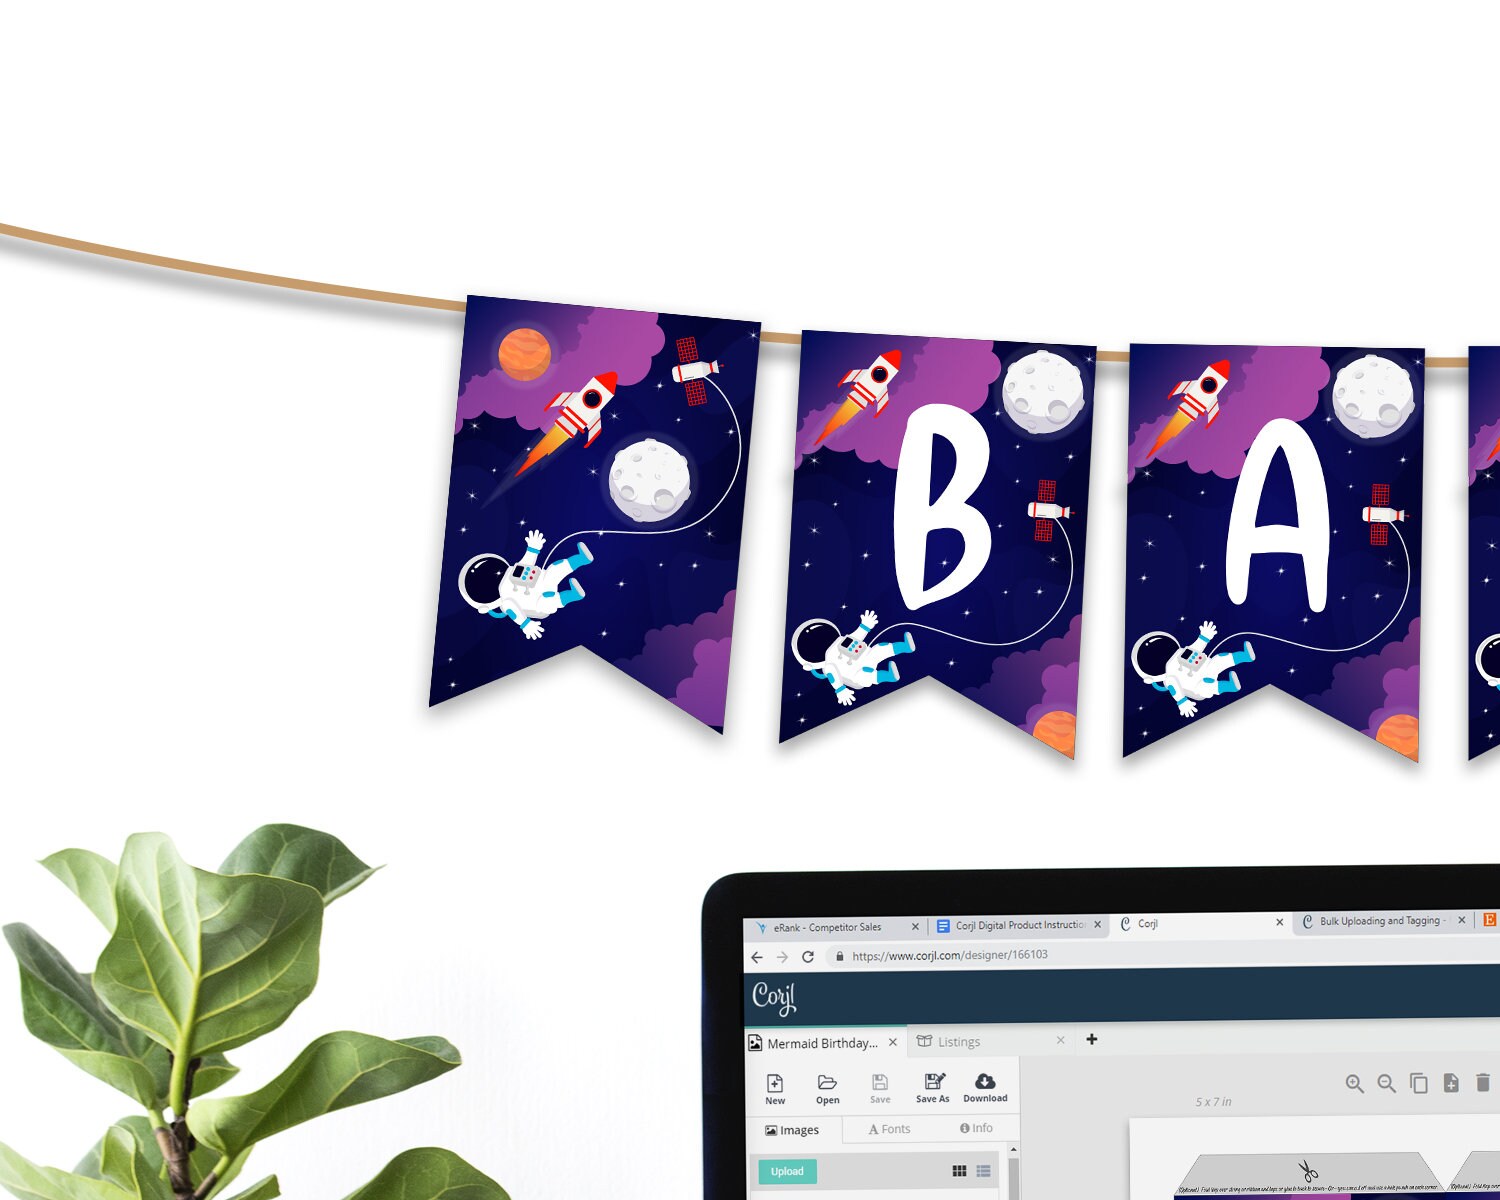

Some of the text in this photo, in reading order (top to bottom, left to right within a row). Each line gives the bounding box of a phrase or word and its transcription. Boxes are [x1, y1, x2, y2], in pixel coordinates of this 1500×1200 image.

[894, 404, 991, 610] B
[1226, 418, 1329, 612] A
[956, 921, 976, 932] Corjl
[978, 921, 1006, 932] Digital
[1009, 920, 1042, 930] Product
[1138, 918, 1158, 931] Corjl
[1321, 915, 1440, 928] Bulk Uploading and Tagging
[774, 922, 882, 934] eRank Competitor Sales
[853, 949, 1048, 963] https://www.corjl.com/designer/166103
[752, 981, 797, 1018] Corjl
[768, 1037, 818, 1049] Mermaid
[939, 1037, 981, 1050] Listings
[765, 1097, 786, 1105] New
[816, 1096, 840, 1107] Open
[870, 1095, 891, 1104] Save
[916, 1095, 950, 1103] Save As
[963, 1094, 1008, 1102] Download
[1222, 1096, 1232, 1106] in
[781, 1126, 819, 1138] Images
[882, 1124, 911, 1134] Fonts
[973, 1122, 993, 1133] Info
[771, 1166, 804, 1178] Upload
